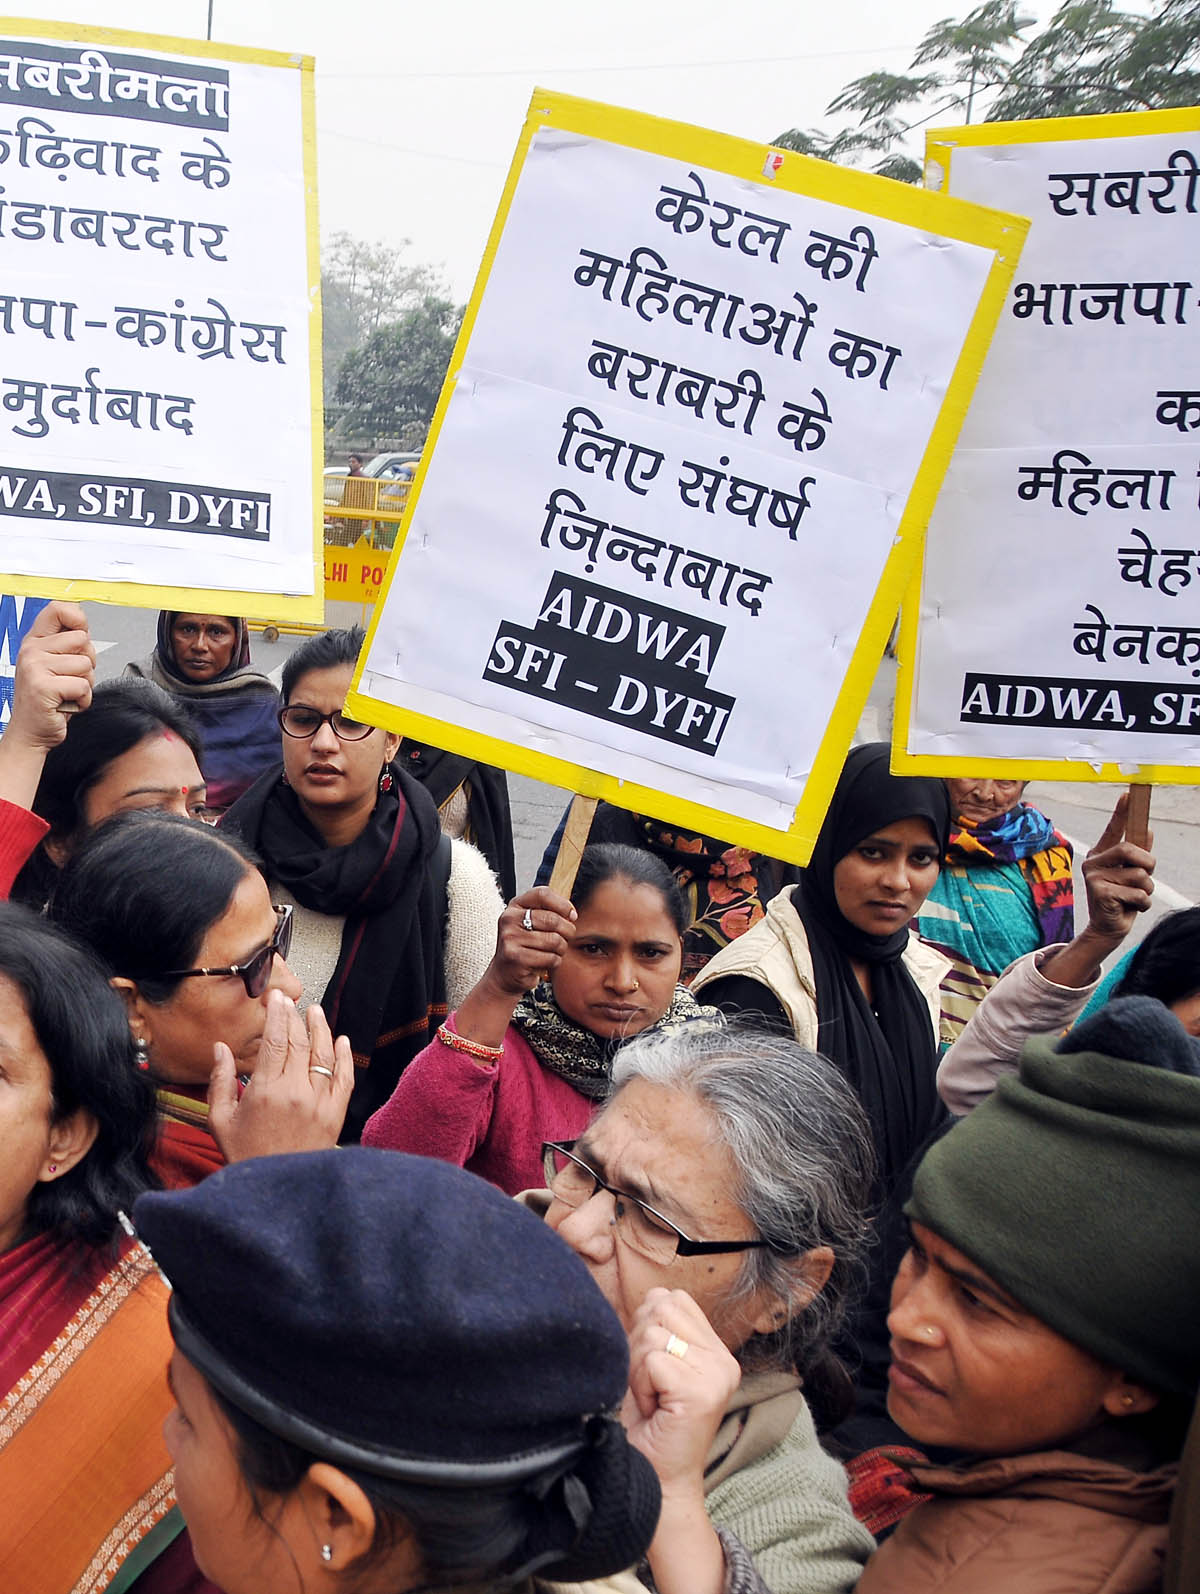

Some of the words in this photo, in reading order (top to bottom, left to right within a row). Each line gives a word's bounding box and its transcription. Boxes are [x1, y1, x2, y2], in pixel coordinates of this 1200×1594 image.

[180, 129, 232, 190] के
[655, 172, 792, 265] केरल
[804, 225, 880, 293] की
[573, 246, 818, 362] महिलाओं
[828, 328, 903, 391] का
[1012, 281, 1200, 326] भाजपा
[2, 367, 196, 439] मुर्दाबाद
[587, 339, 766, 436] बराबरी
[777, 387, 833, 453] के
[77, 483, 155, 526] SFI,
[167, 490, 270, 534] DYFI
[557, 406, 666, 496] लिए
[678, 455, 817, 541] संघर्ष
[1017, 449, 1177, 516] महिला
[542, 488, 774, 617] ज़िन्दाबाद
[1117, 527, 1200, 597] चेह
[538, 588, 714, 676] AIDWA
[487, 636, 568, 692] SFI
[608, 673, 730, 746] DYFI
[961, 682, 1137, 730] AIDWA,
